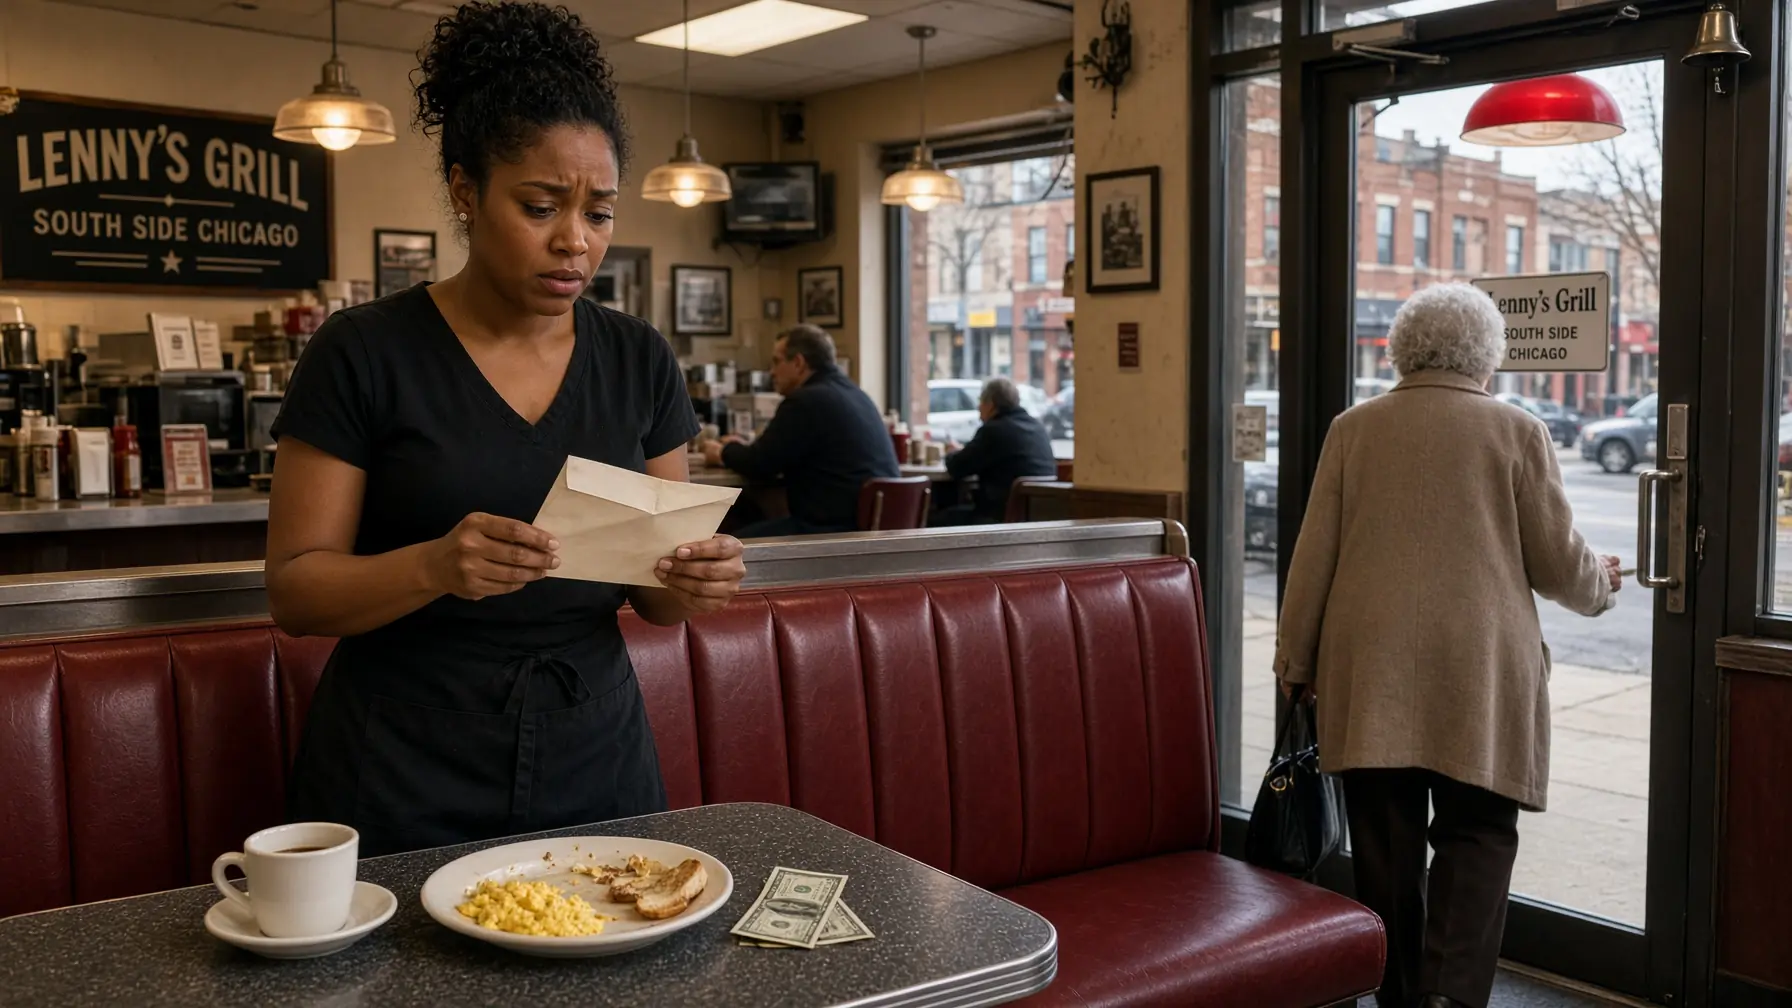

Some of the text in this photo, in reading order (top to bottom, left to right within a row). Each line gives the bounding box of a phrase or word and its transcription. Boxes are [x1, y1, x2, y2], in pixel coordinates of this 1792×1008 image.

[17, 124, 308, 211] LENNY'S GRILL
[33, 209, 298, 248] SOUTH SIDE CHICAGO
[1488, 287, 1597, 319] enny's Grill
[1548, 326, 1578, 340] SIDE
[1509, 347, 1567, 360] CHICAGO
